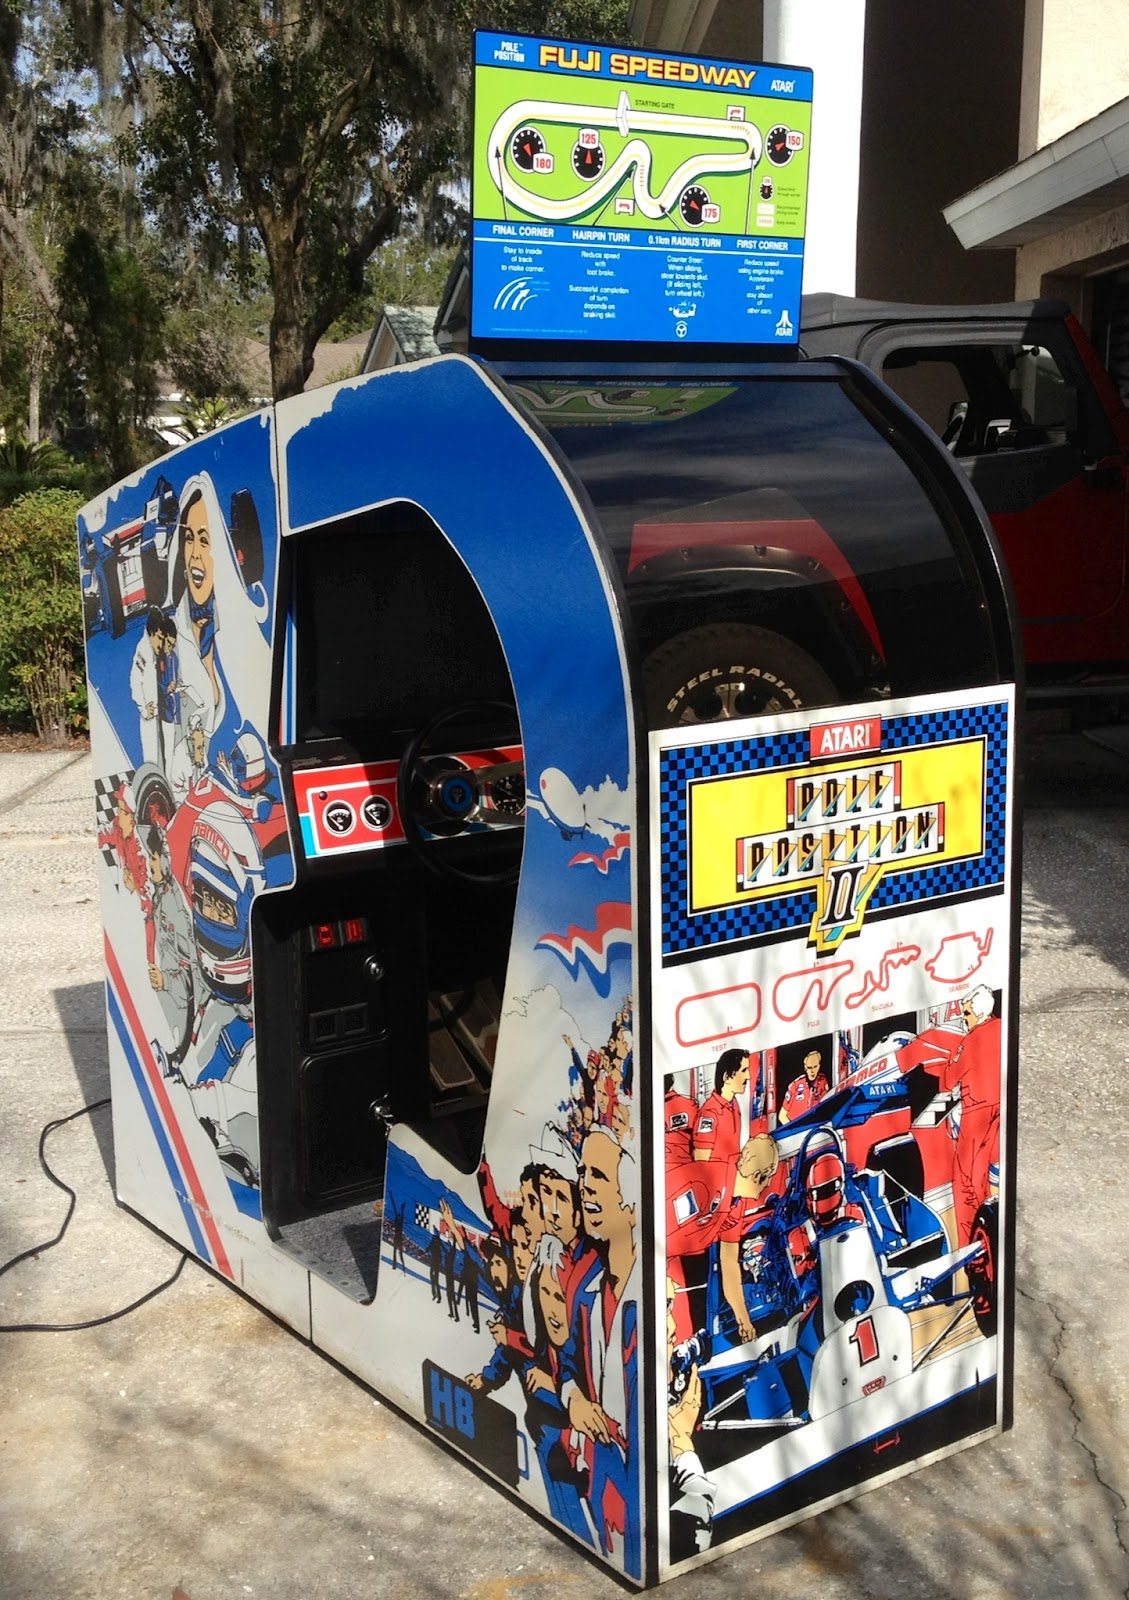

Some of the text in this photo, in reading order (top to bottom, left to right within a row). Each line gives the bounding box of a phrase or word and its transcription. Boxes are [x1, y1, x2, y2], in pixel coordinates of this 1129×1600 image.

[501, 41, 518, 52] POLE
[493, 50, 525, 63] POSITION
[539, 44, 757, 89] FUJI SPEEDWAY
[770, 79, 795, 93] ATARI
[634, 99, 661, 108] STARTING
[581, 133, 596, 145] 125
[788, 135, 801, 147] 150
[535, 157, 551, 169] 180
[704, 208, 717, 219] 175
[492, 224, 555, 238] FINAL CORNER
[572, 229, 630, 243] HAIRPIN TURN
[648, 234, 722, 248] 0.1km RADIUS TURN
[736, 239, 789, 251] FIRST CORNER
[775, 327, 793, 337] ATARI
[667, 665, 803, 712] STEEL RADIAL
[820, 722, 871, 753] ATARI
[799, 770, 885, 822] POLE
[748, 810, 933, 882] POSITION
[948, 982, 970, 993] SEASIDE
[871, 1001, 894, 1012] SUZUKA
[806, 1020, 821, 1028] FUJI
[712, 1043, 727, 1052] TEST
[869, 1084, 897, 1096] ATARI
[848, 1315, 880, 1368] 1
